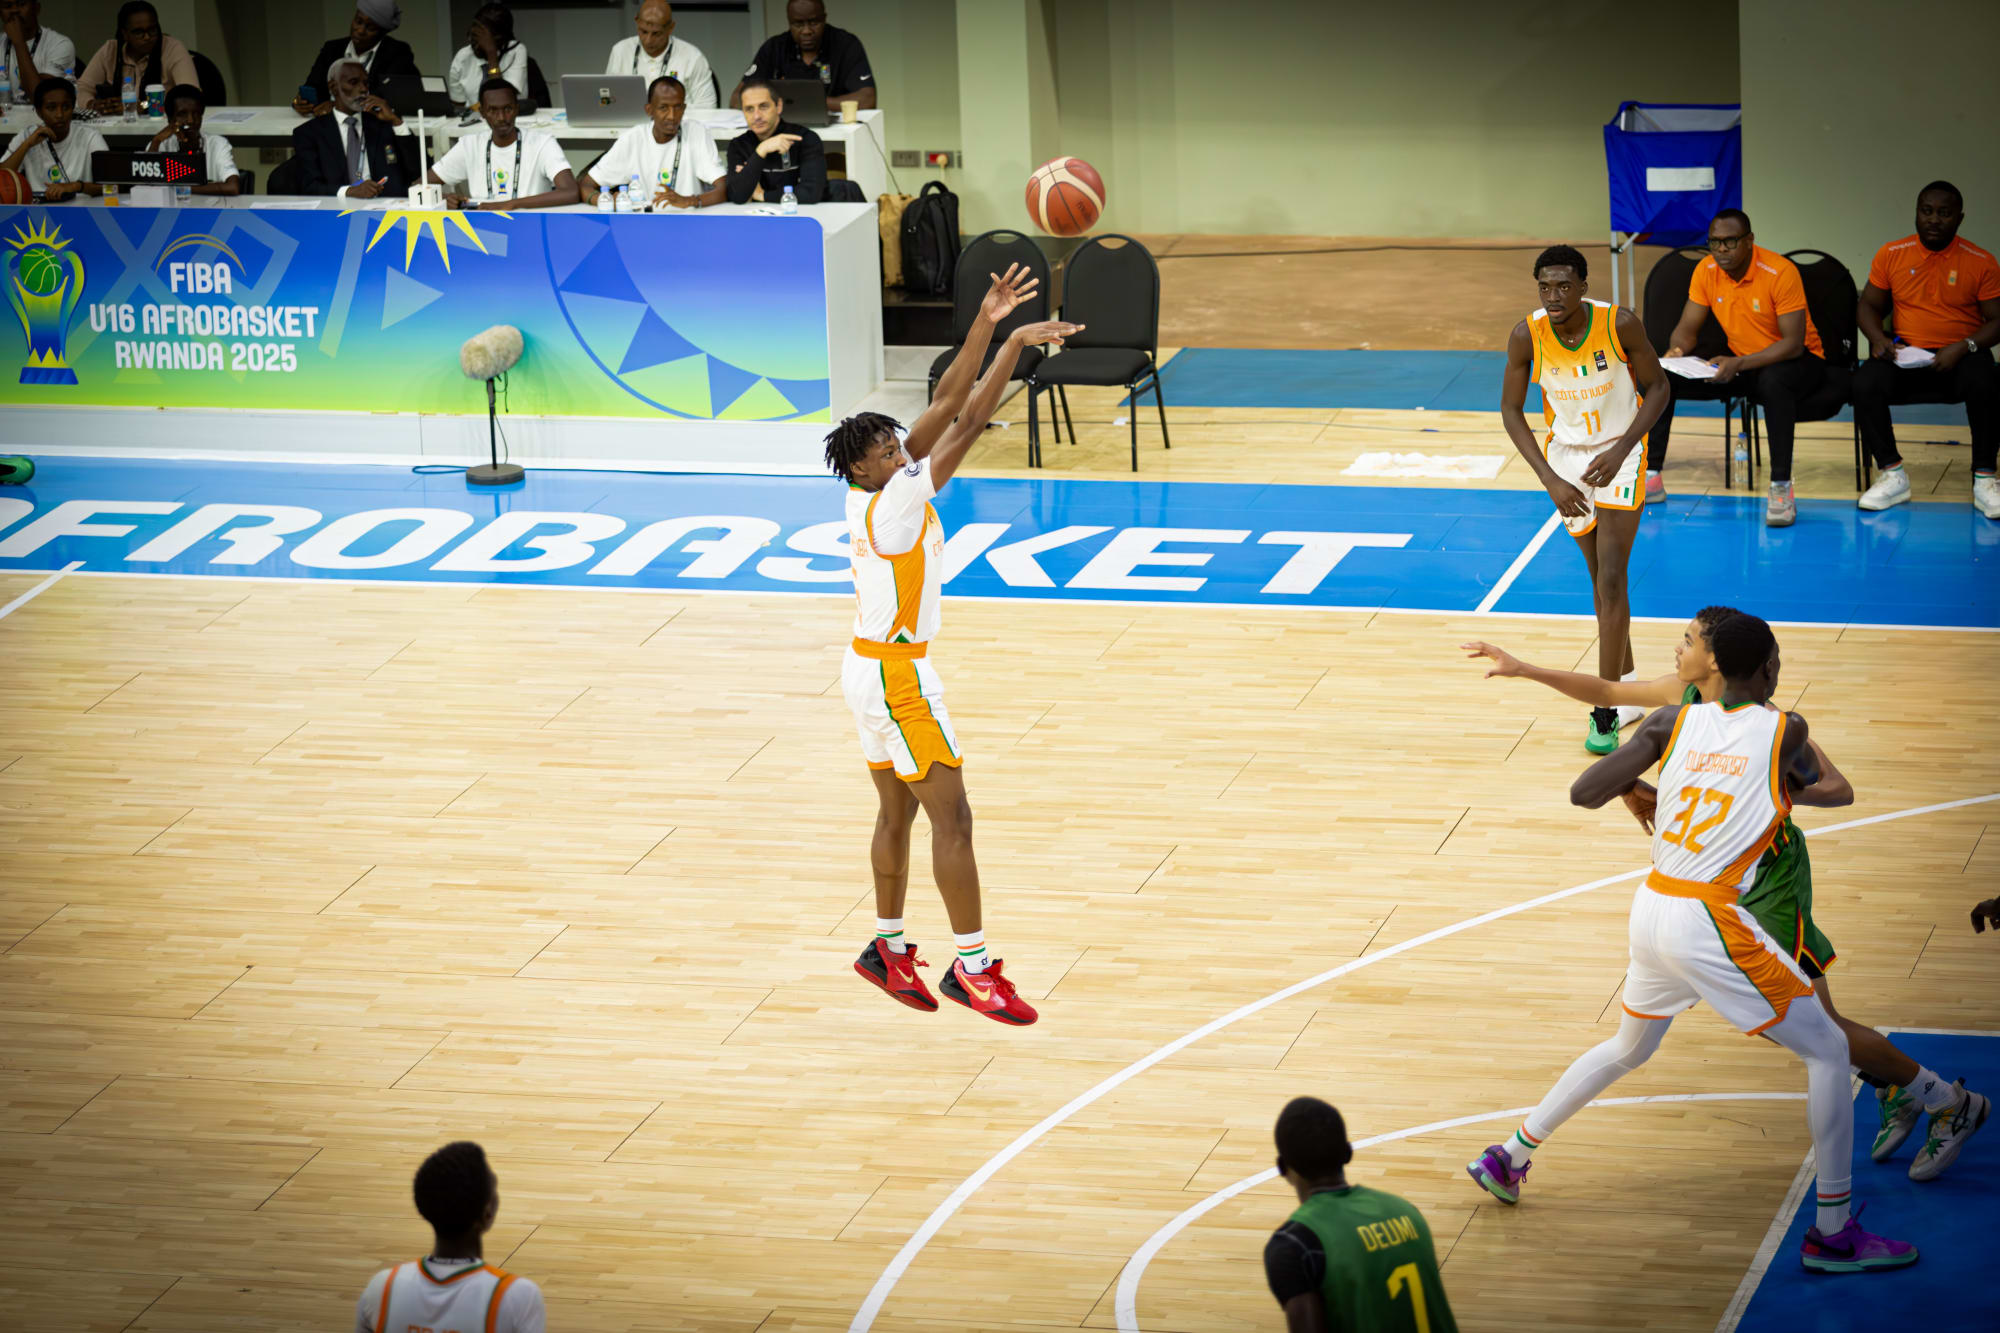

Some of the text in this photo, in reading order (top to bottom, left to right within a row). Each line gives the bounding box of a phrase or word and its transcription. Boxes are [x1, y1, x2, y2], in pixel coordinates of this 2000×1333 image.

[132, 161, 164, 178] POSS.
[169, 262, 232, 294] FIBA
[89, 303, 319, 338] U16 AFROBASKET
[115, 341, 297, 372] RWANDA 2025
[1581, 409, 1602, 436] 11
[0, 497, 1413, 595] FROBASKET
[1661, 785, 1736, 855] 32
